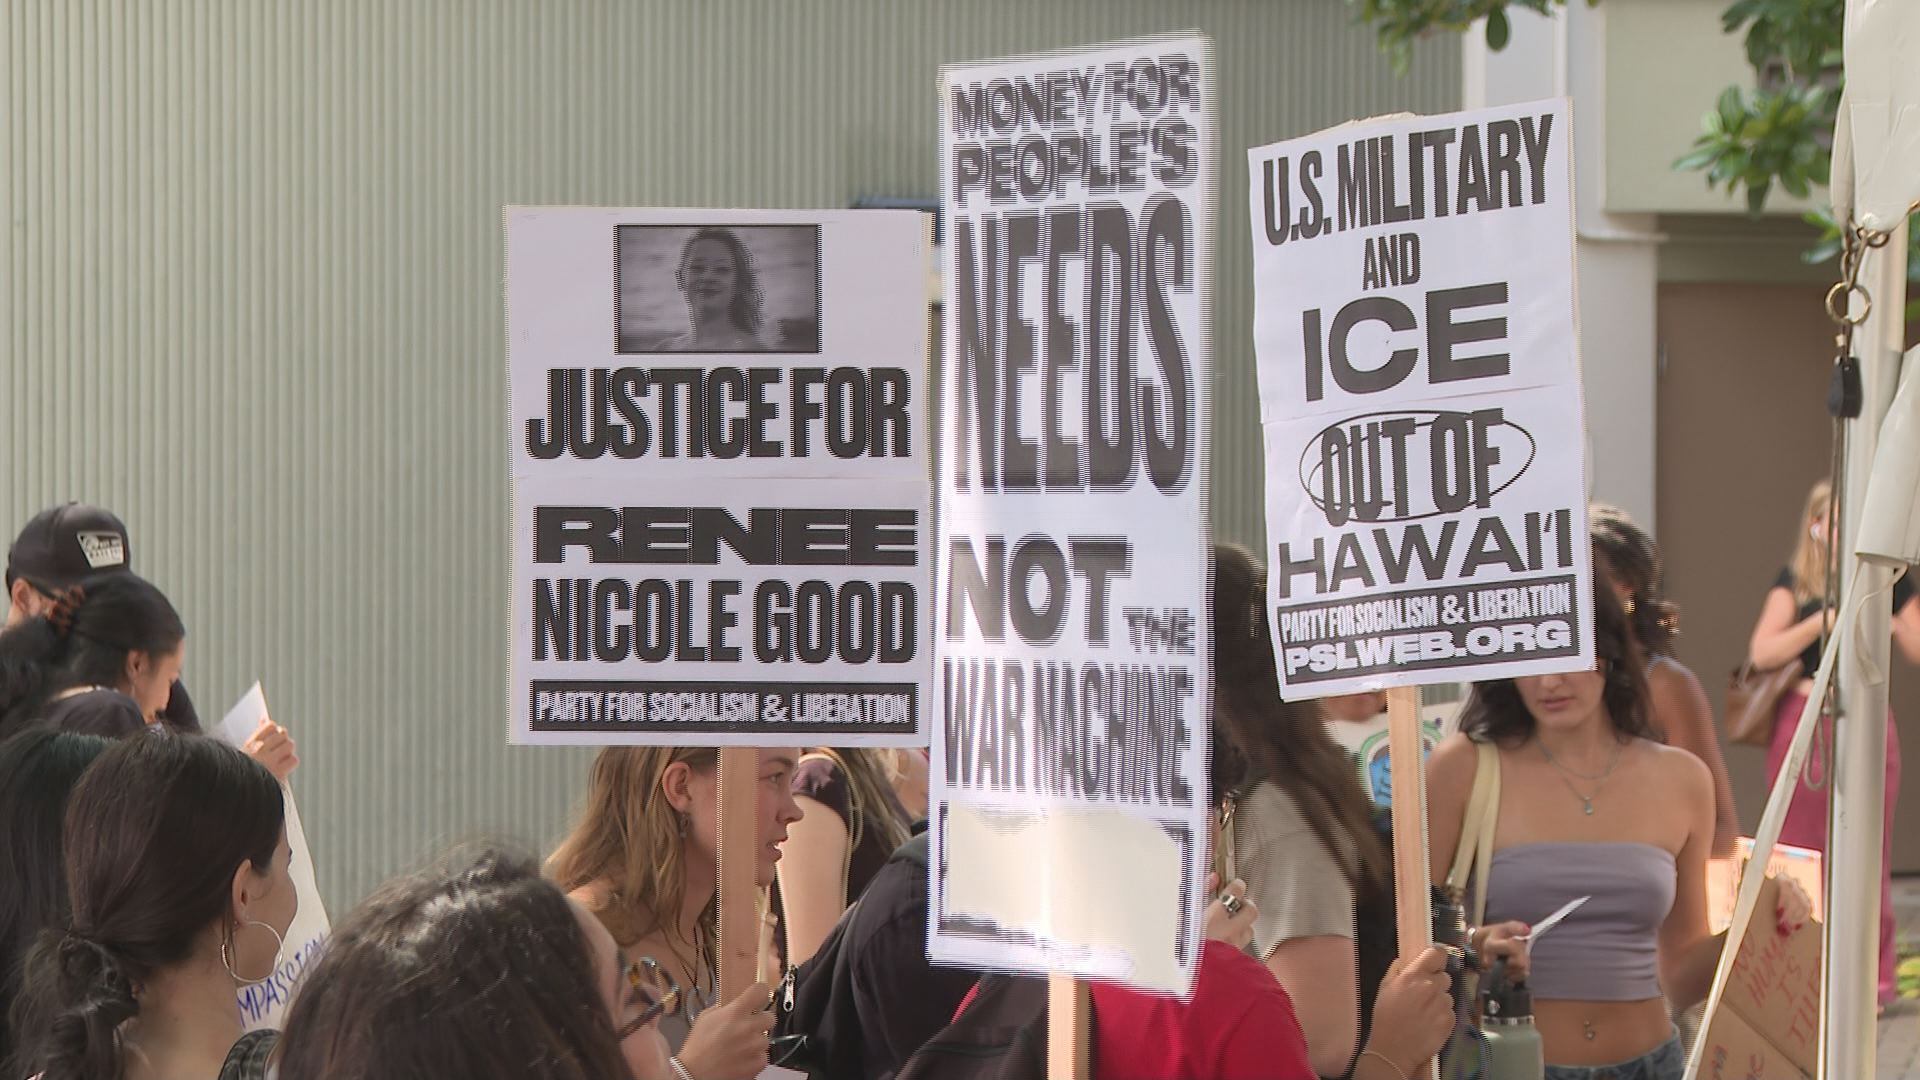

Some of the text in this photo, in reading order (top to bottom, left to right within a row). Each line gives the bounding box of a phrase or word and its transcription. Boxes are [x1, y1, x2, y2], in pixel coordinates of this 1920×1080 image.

[950, 53, 1200, 140] MONEY FOR
[952, 115, 1199, 208] PEOPLE'S
[1263, 113, 1554, 246] U.S. MILITARY
[1363, 232, 1421, 291] AND
[954, 191, 1194, 497] NEEDS
[1302, 281, 1511, 402] ICE
[525, 366, 913, 460] JUSTICE FOR
[1320, 407, 1504, 527] OUT OF
[532, 506, 919, 567] RENEE
[532, 578, 919, 665] NICOLE GOOD
[946, 531, 1196, 655] NOT THE
[1280, 582, 1571, 644] PARTY FOR SOCIALISM & LIBERATION
[1286, 620, 1572, 675] PSLWEB.ORG
[536, 691, 911, 724] PARTY FOR SOCIALISM & LIBERATION
[943, 657, 1195, 808] WAR MACHINE
